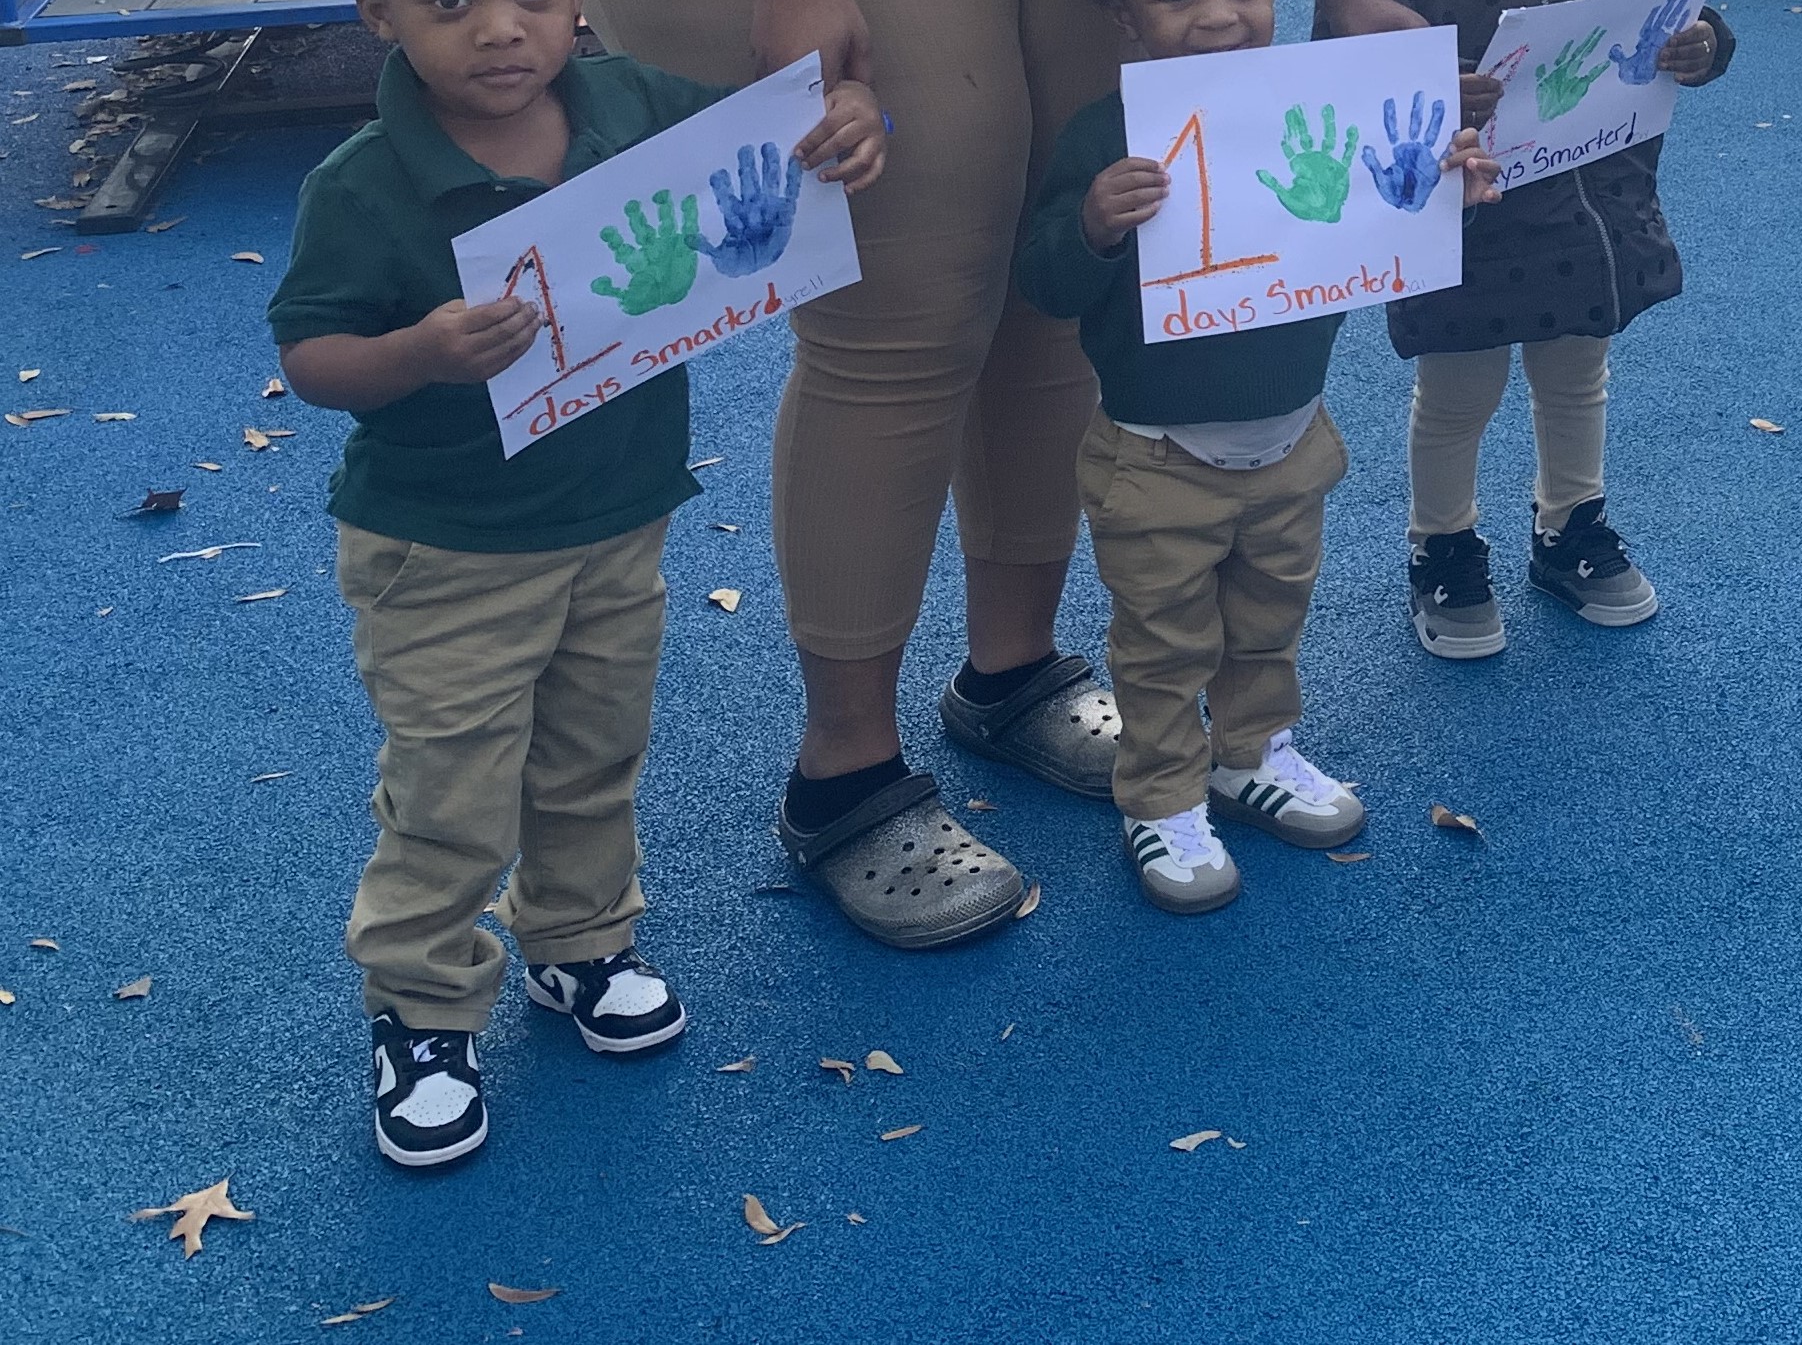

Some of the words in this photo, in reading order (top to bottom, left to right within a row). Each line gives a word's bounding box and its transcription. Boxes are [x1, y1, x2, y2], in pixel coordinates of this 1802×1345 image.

[1141, 111, 1280, 287] 1
[501, 244, 623, 421] 1
[1162, 288, 1258, 337] days
[527, 375, 622, 437] days
